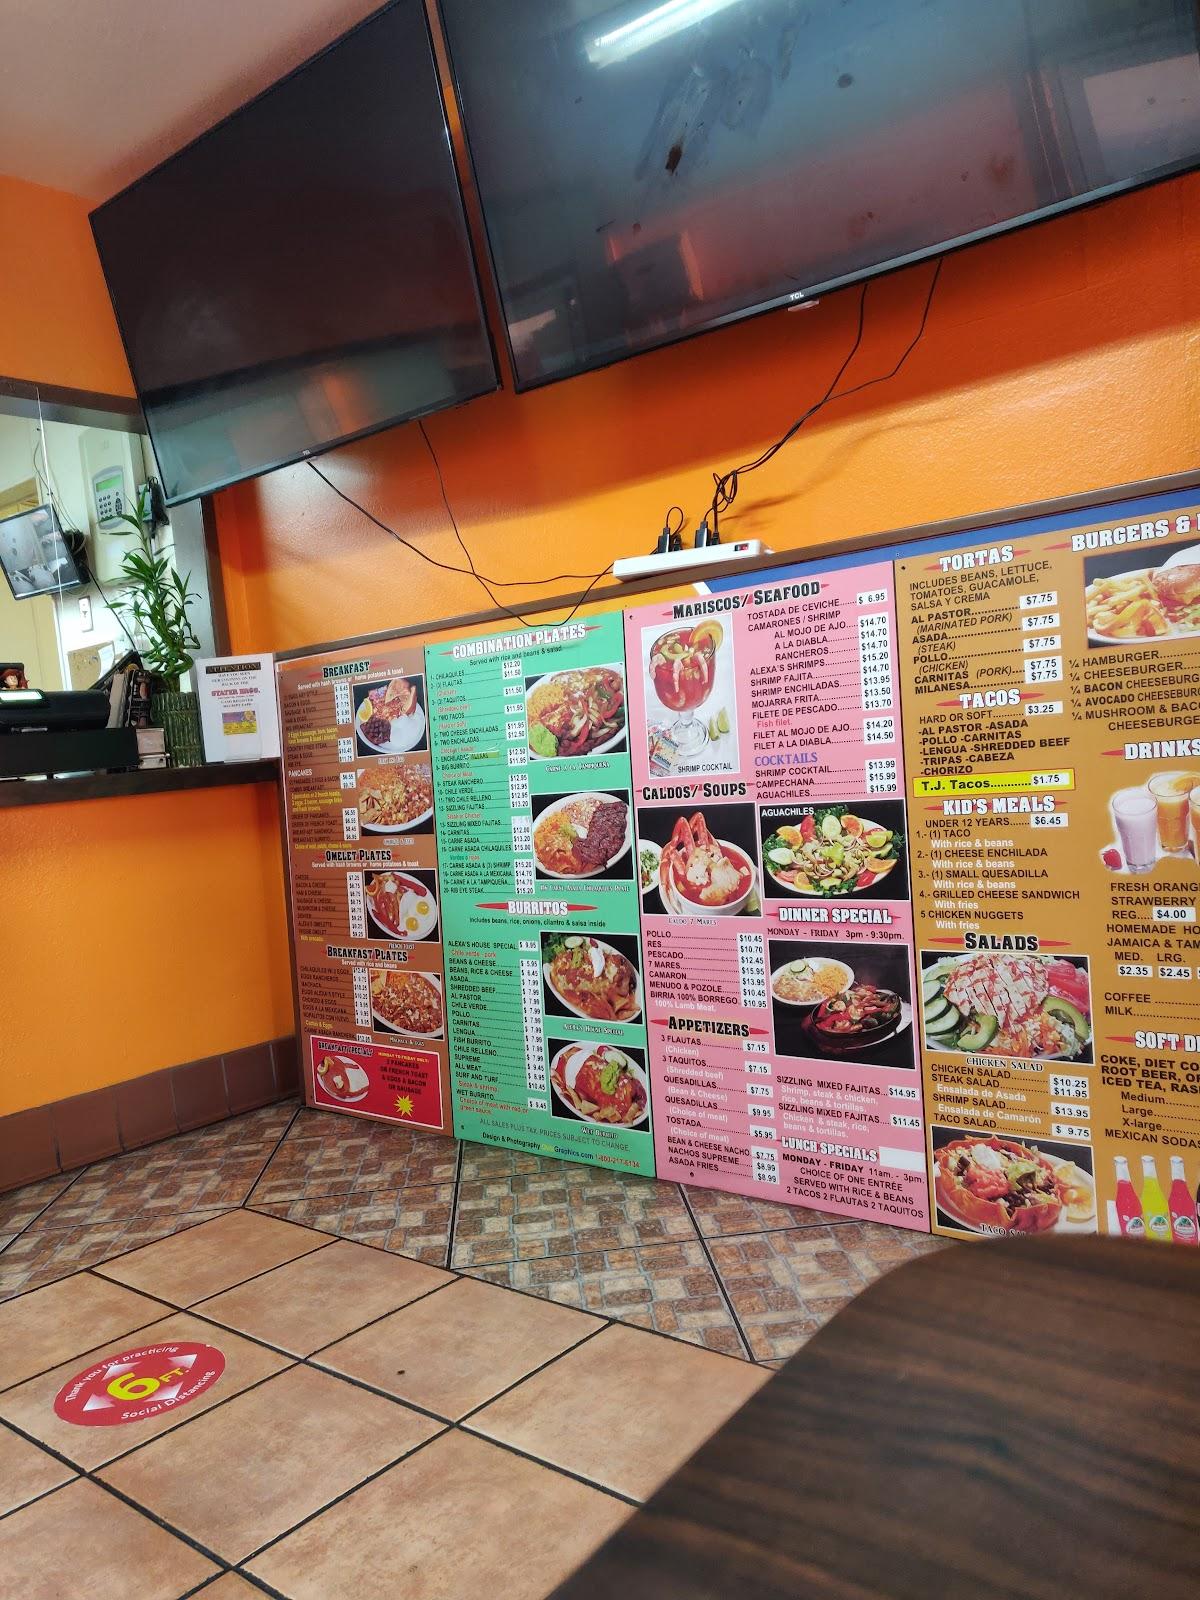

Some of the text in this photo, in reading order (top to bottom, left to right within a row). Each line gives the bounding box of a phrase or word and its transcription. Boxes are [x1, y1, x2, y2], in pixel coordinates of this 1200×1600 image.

[790, 292, 804, 300] TCL
[1071, 516, 1191, 551] BURGERS &
[939, 545, 1013, 572] TORTAS
[910, 577, 957, 591] INCLUDES
[970, 574, 1039, 592] GUACAMOLE,
[754, 582, 820, 604] SEAFOOD
[911, 592, 990, 611] SALSA Y CREMA
[911, 616, 924, 624] AL
[1026, 593, 1053, 605] $7.75
[748, 608, 785, 620] TOSTADA
[748, 610, 841, 631] CAMARONES SHRIMP
[917, 613, 1013, 634] (MARINATED PORK)
[453, 624, 587, 658] COMBINATION PLATES
[323, 662, 370, 678] BREAKFAST
[919, 660, 968, 675] (CHICKEN)
[752, 688, 782, 697] SHRIMP
[864, 676, 890, 685] $13.95
[1084, 682, 1122, 693] BACON
[960, 689, 1021, 709] TACOS
[1085, 694, 1135, 706] AVOCADO
[920, 714, 946, 724] HARD
[950, 713, 964, 721] OR
[1028, 705, 1054, 714] $3.25
[1040, 738, 1070, 747] BEEF
[755, 752, 818, 766] COCKTAILS
[678, 763, 732, 773] SHRIMP COCKTAIL
[703, 783, 746, 797] SOUPS
[921, 781, 946, 791] T.J.
[1033, 775, 1060, 785] $1.75
[762, 807, 814, 816] AGUACHILES
[943, 796, 1055, 816] KID'S MEALS
[926, 818, 959, 828] UNDER
[962, 818, 972, 827] 12
[1035, 817, 1061, 825] $6.45
[931, 839, 1013, 848] With rice & beans
[326, 850, 392, 861] OMELET PLATES
[945, 848, 1048, 858] CHEESE ENCHILADA
[933, 891, 1080, 899] GRILLED CHEESE SANDWICH
[1112, 897, 1195, 906] STRAWBERRY
[508, 900, 568, 916] BURRITOS
[778, 907, 893, 924] DINNER SPECIAL
[1157, 910, 1186, 918] $4.00
[767, 928, 799, 936] MONDAY
[811, 929, 839, 937] FRIDAY
[846, 930, 863, 938] 3pm
[936, 921, 980, 930] With fries
[1107, 924, 1176, 934] HOMEMADE
[965, 933, 1039, 951] SALADS
[327, 947, 408, 962] BREAKFAST PLATES
[1120, 966, 1190, 977] $2.35 $2.45
[743, 978, 765, 986] $13.95
[650, 991, 766, 1008] BIRRIA 100% BORREGO $10.95
[1105, 992, 1150, 1002] COFFEE
[669, 1016, 749, 1037] APPETIZERS
[1135, 1031, 1180, 1051] SOFT
[1101, 1055, 1175, 1069] COKE, DIET
[931, 1064, 974, 1075] CHICKEN
[1053, 1078, 1087, 1088] $10.25
[776, 1076, 812, 1087] SIZZLING
[817, 1080, 843, 1090] MIXED
[889, 1088, 916, 1098] $14.95
[937, 1084, 1026, 1101] Ensalada de Asada
[933, 1094, 969, 1104] SHRIMP
[1055, 1107, 1088, 1118] $13.95
[1105, 1129, 1158, 1143] MEXICAN
[781, 1136, 878, 1162] LUNCH SPECIALS
[783, 1153, 821, 1166] MONDAY
[830, 1161, 864, 1173] FRIDAY
[800, 1168, 831, 1178] CHOICE
[848, 1175, 865, 1185] ONE
[65, 1346, 179, 1402] Thank you for practicing
[107, 1372, 160, 1400] 6
[121, 1370, 215, 1420] Social Distancing
